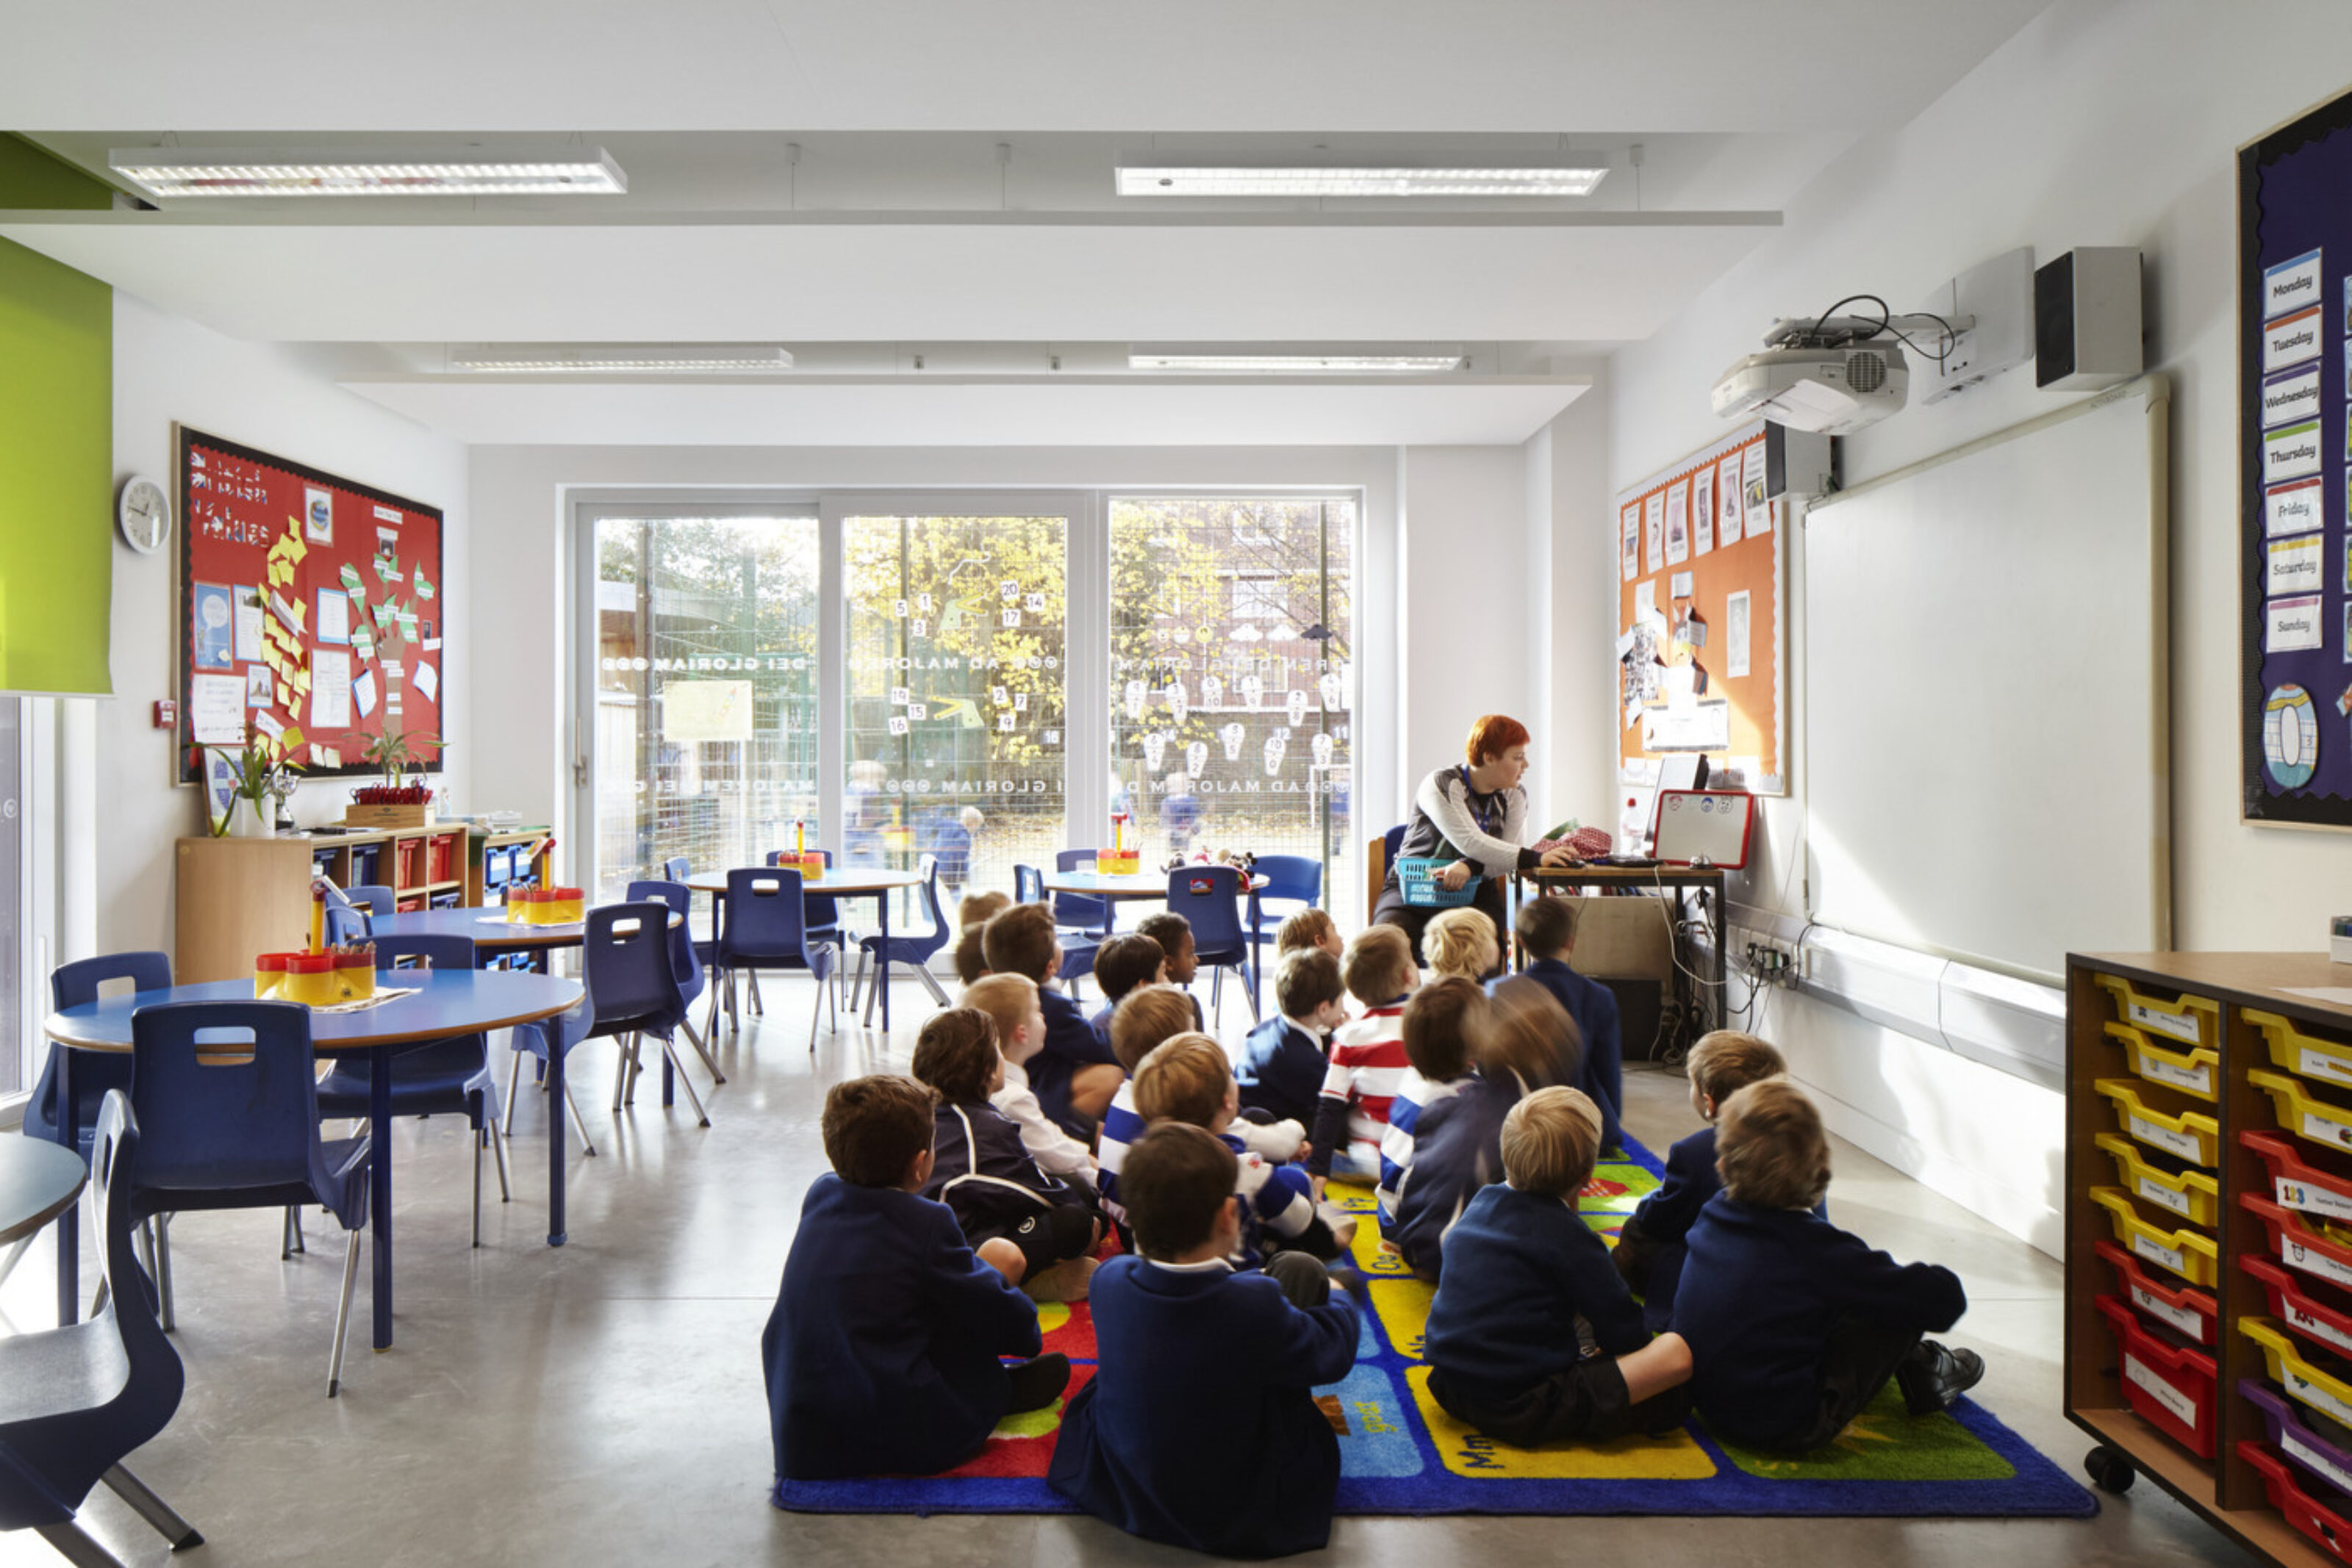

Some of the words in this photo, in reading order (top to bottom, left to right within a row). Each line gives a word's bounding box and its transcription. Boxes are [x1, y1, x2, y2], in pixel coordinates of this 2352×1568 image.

[2273, 275, 2312, 298] Monday
[2272, 331, 2314, 352] Tuesday
[2265, 386, 2319, 409] Wednesday
[2270, 443, 2316, 464] Thursday
[2278, 502, 2309, 518] Friday
[2273, 561, 2316, 576] Saturday
[2277, 617, 2311, 633] Sunday
[2283, 1184, 2305, 1205] 123
[1353, 1401, 1398, 1434] goat
